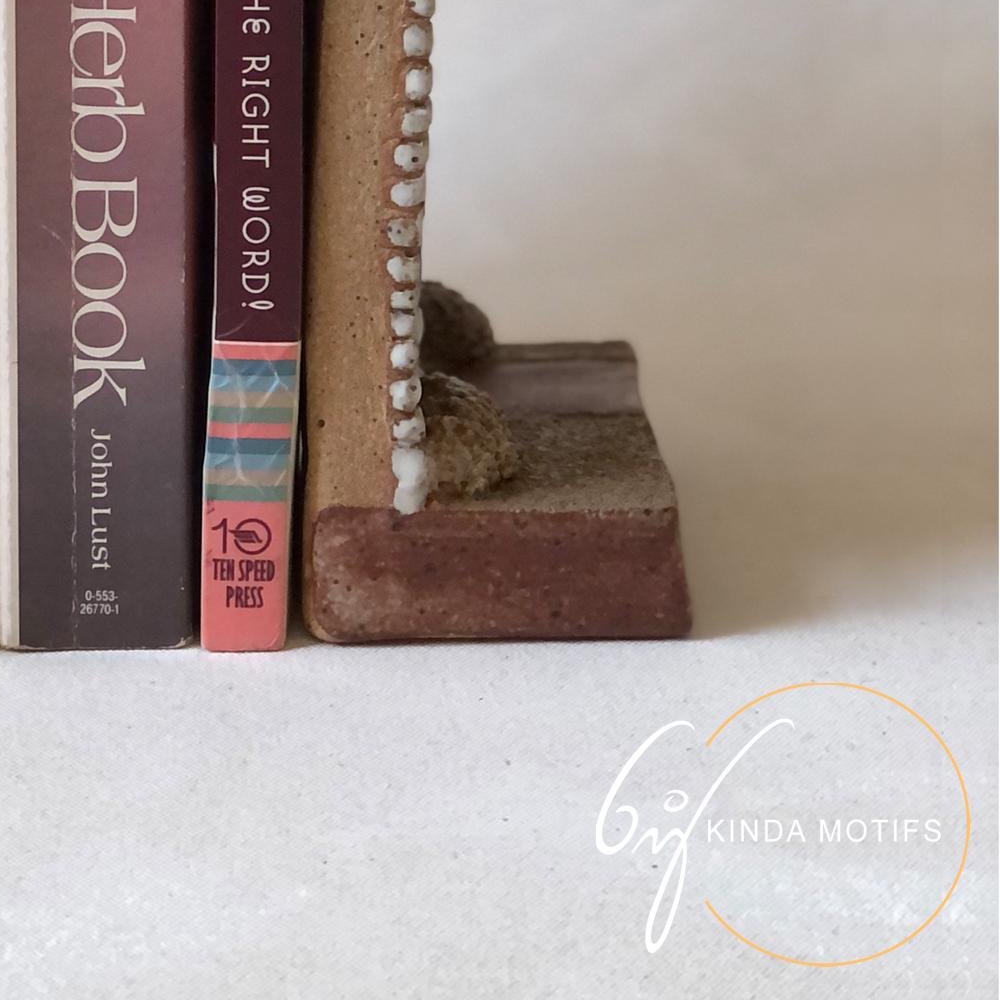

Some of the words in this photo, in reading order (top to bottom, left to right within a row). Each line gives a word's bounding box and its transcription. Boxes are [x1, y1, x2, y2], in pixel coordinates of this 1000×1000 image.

[241, 54, 270, 169] RIGHT
[241, 186, 275, 311] WORD!
[71, 177, 146, 409] Book
[90, 428, 113, 499] John
[91, 507, 112, 570] Lust
[212, 558, 235, 581] TEN
[238, 559, 275, 582] SPEED
[79, 603, 120, 615] 26770-1
[225, 585, 264, 608] PRESS
